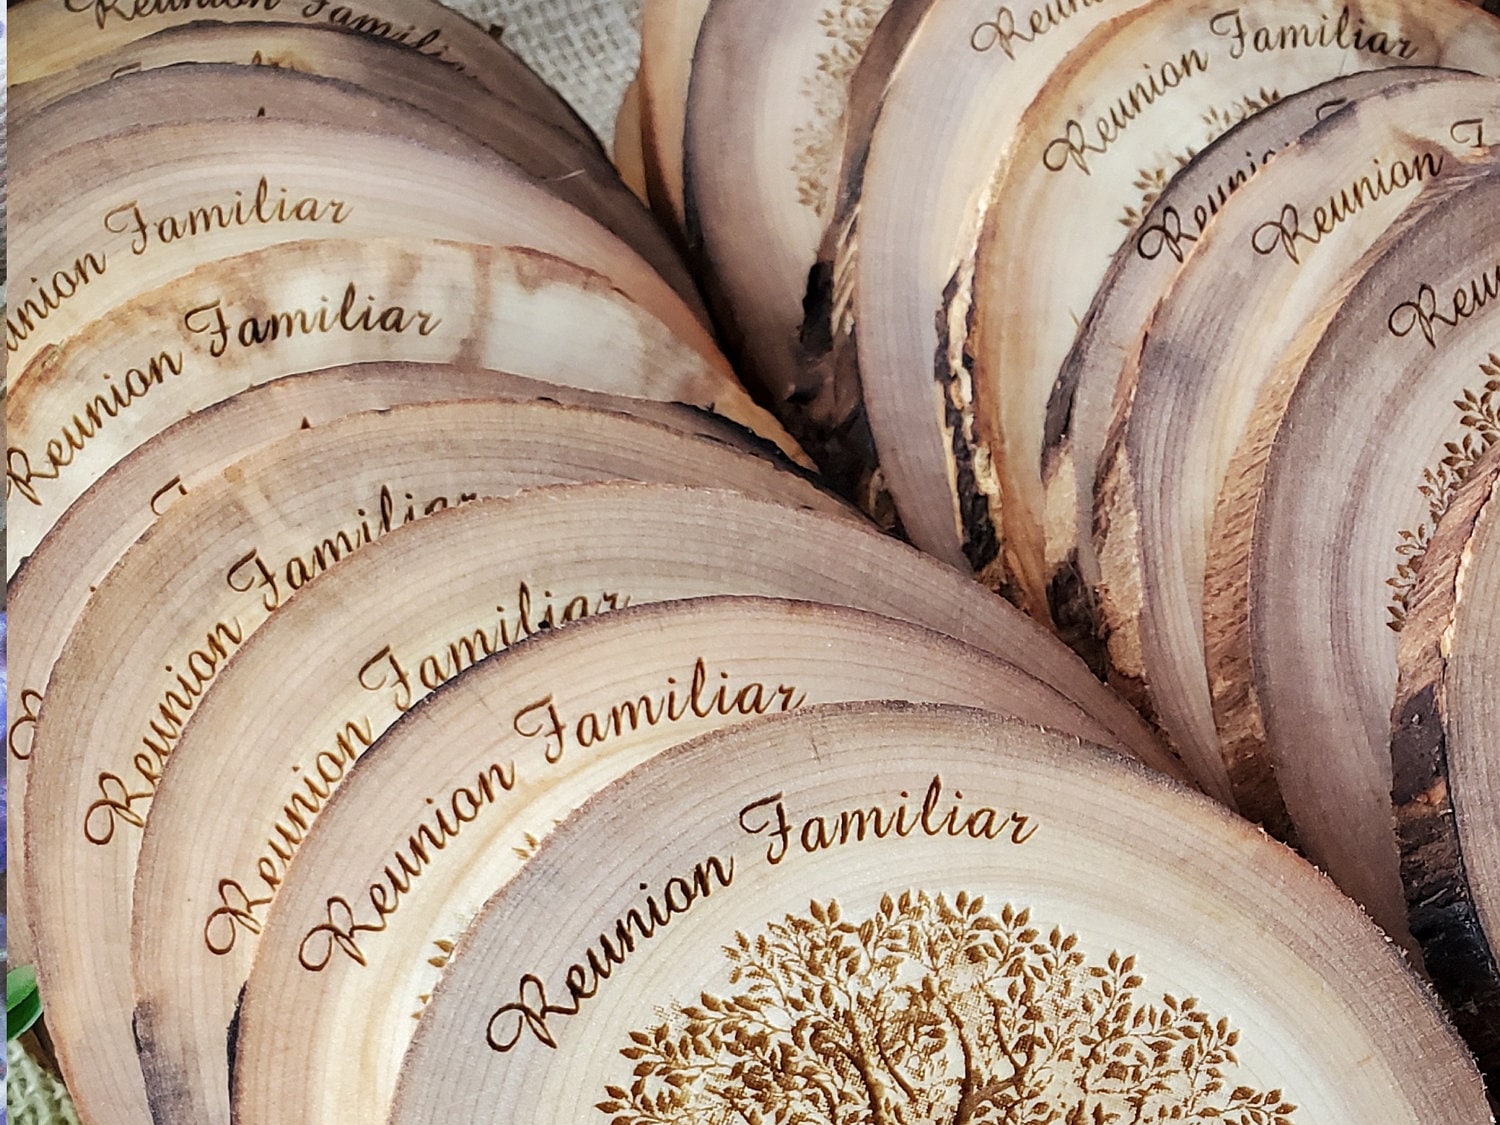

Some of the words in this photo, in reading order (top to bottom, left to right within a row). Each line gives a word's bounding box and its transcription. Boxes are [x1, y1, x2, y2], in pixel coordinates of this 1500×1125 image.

[1042, 47, 1209, 177] Reunion
[1210, 4, 1418, 60] Familiar
[105, 175, 353, 254] Familiar
[1251, 151, 1444, 264] Reunion
[7, 348, 183, 506] Reunion
[185, 282, 441, 357] Familiar
[84, 616, 242, 845] Reunion
[205, 714, 373, 955] Reunion
[299, 758, 517, 972] Reunion
[514, 656, 807, 763] Familiar
[486, 851, 734, 1054] Reunion
[738, 774, 1040, 866] Familiar
